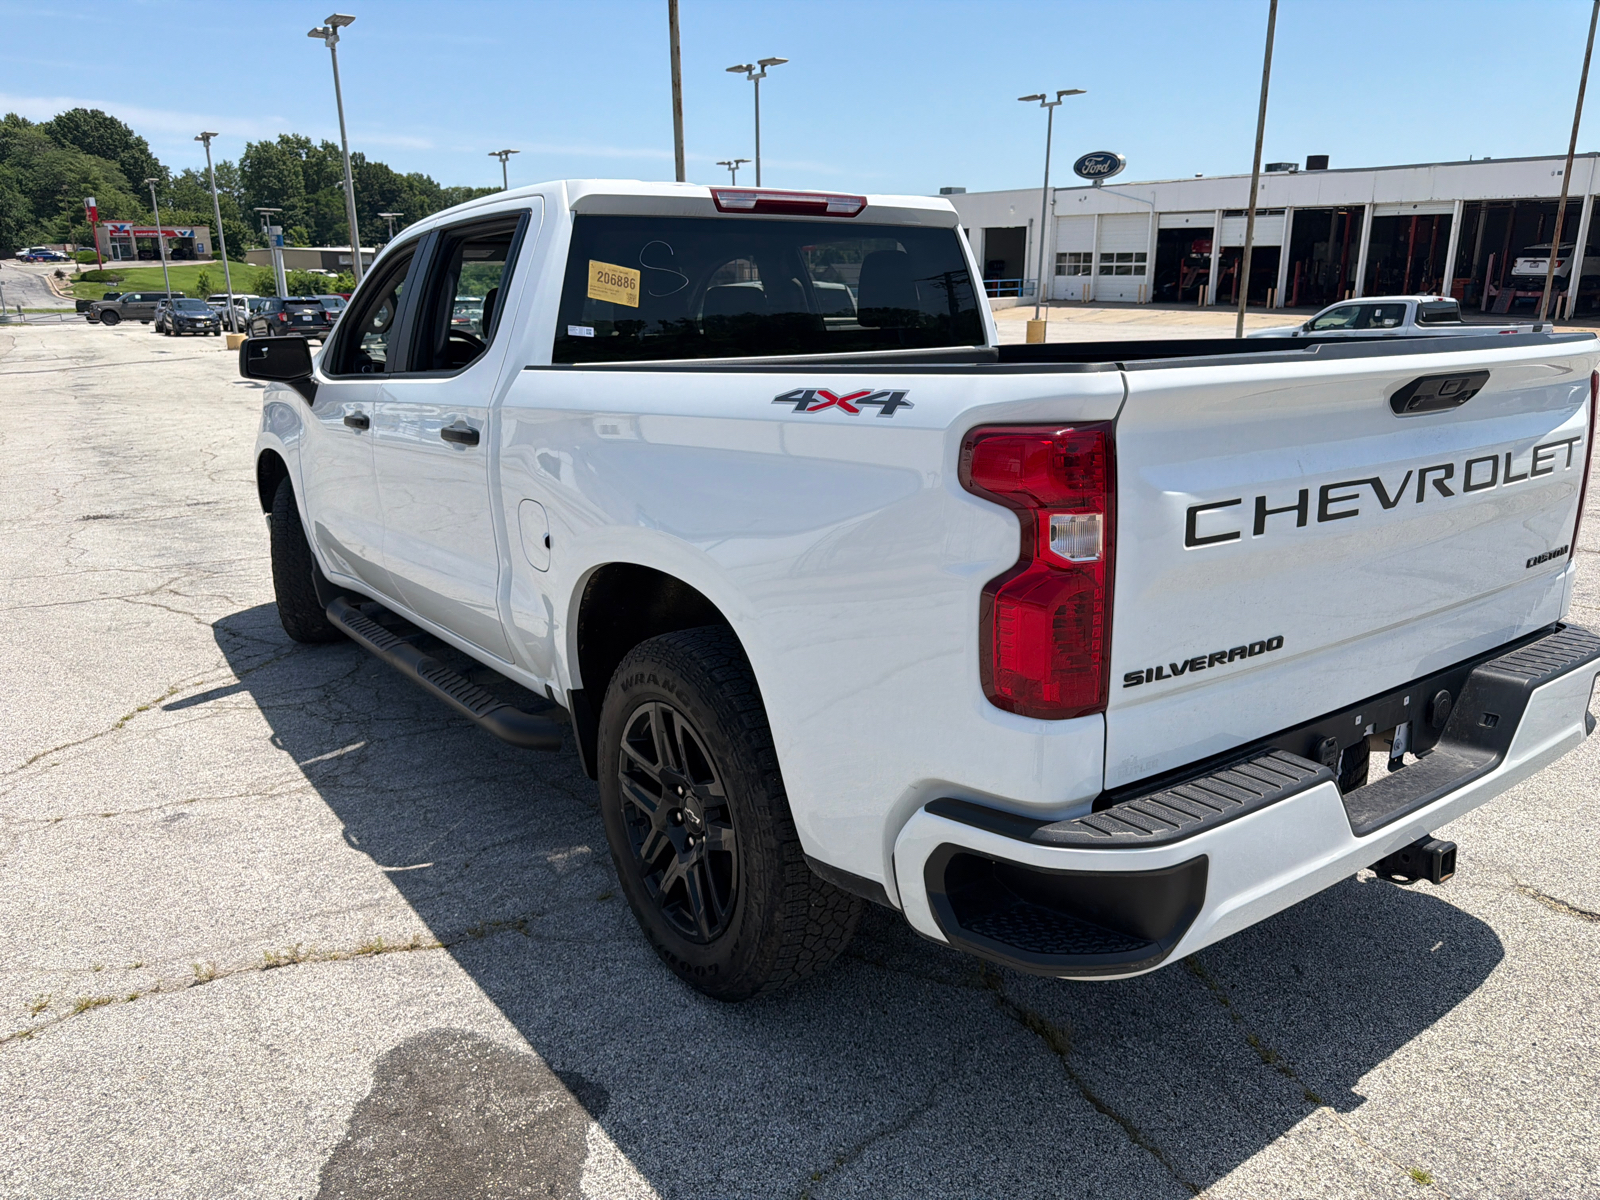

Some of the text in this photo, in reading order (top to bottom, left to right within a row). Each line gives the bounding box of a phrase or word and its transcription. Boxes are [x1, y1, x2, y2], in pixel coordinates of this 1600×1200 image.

[1081, 156, 1112, 174] Ford
[596, 270, 636, 290] 206886
[639, 240, 689, 297] S
[1184, 435, 1583, 549] CHEVROLET
[1122, 635, 1285, 689] SILVERADO
